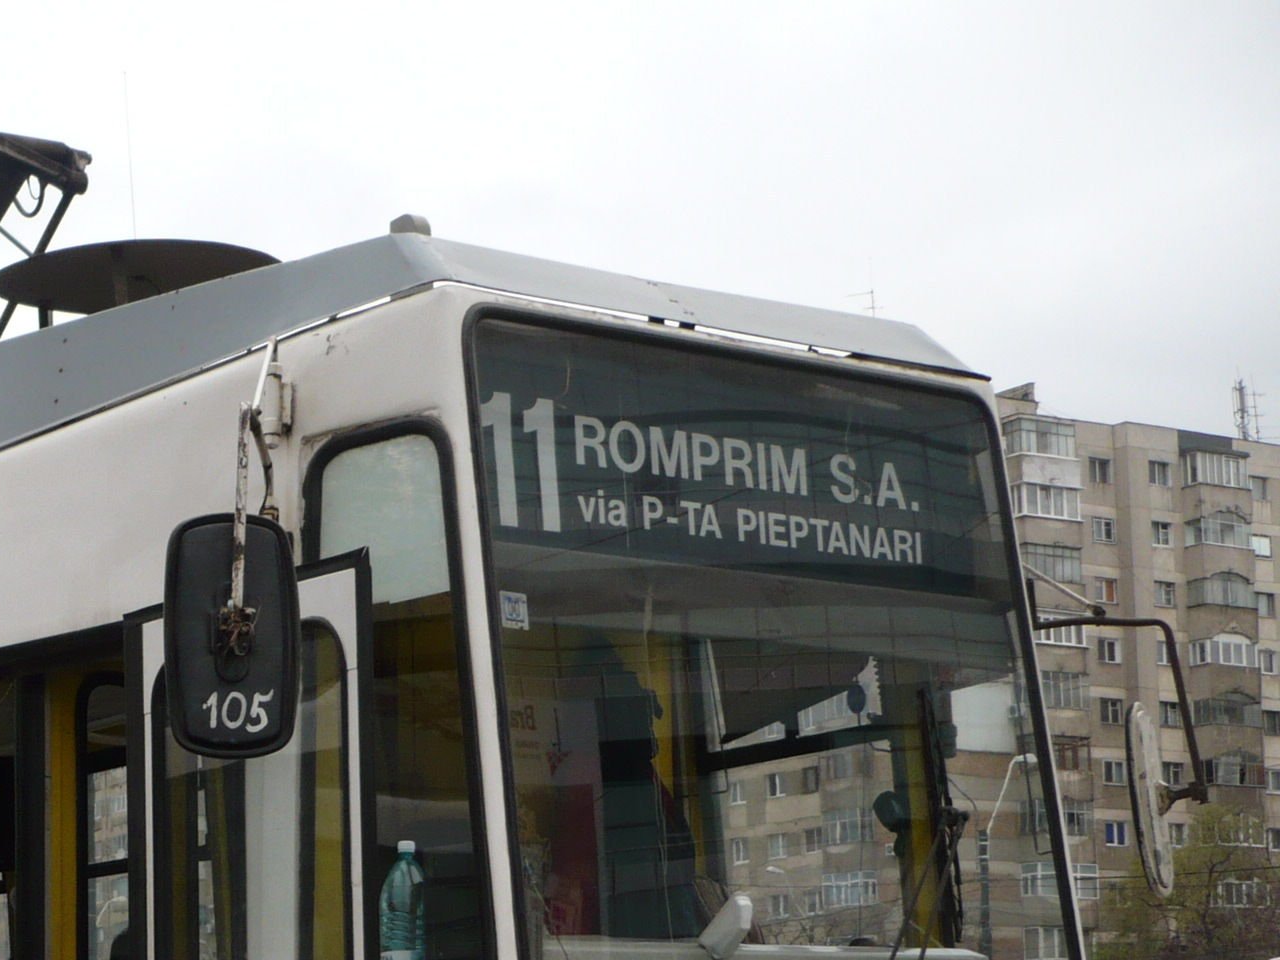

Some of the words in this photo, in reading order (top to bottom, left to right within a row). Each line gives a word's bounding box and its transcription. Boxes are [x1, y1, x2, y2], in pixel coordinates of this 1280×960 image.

[481, 391, 561, 533] 11
[574, 414, 809, 498] ROMPRIM
[829, 452, 921, 512] S.A.
[578, 489, 627, 527] via
[643, 495, 722, 539] P-TA
[736, 508, 922, 566] PIEPTANARI
[202, 689, 275, 733] 105
